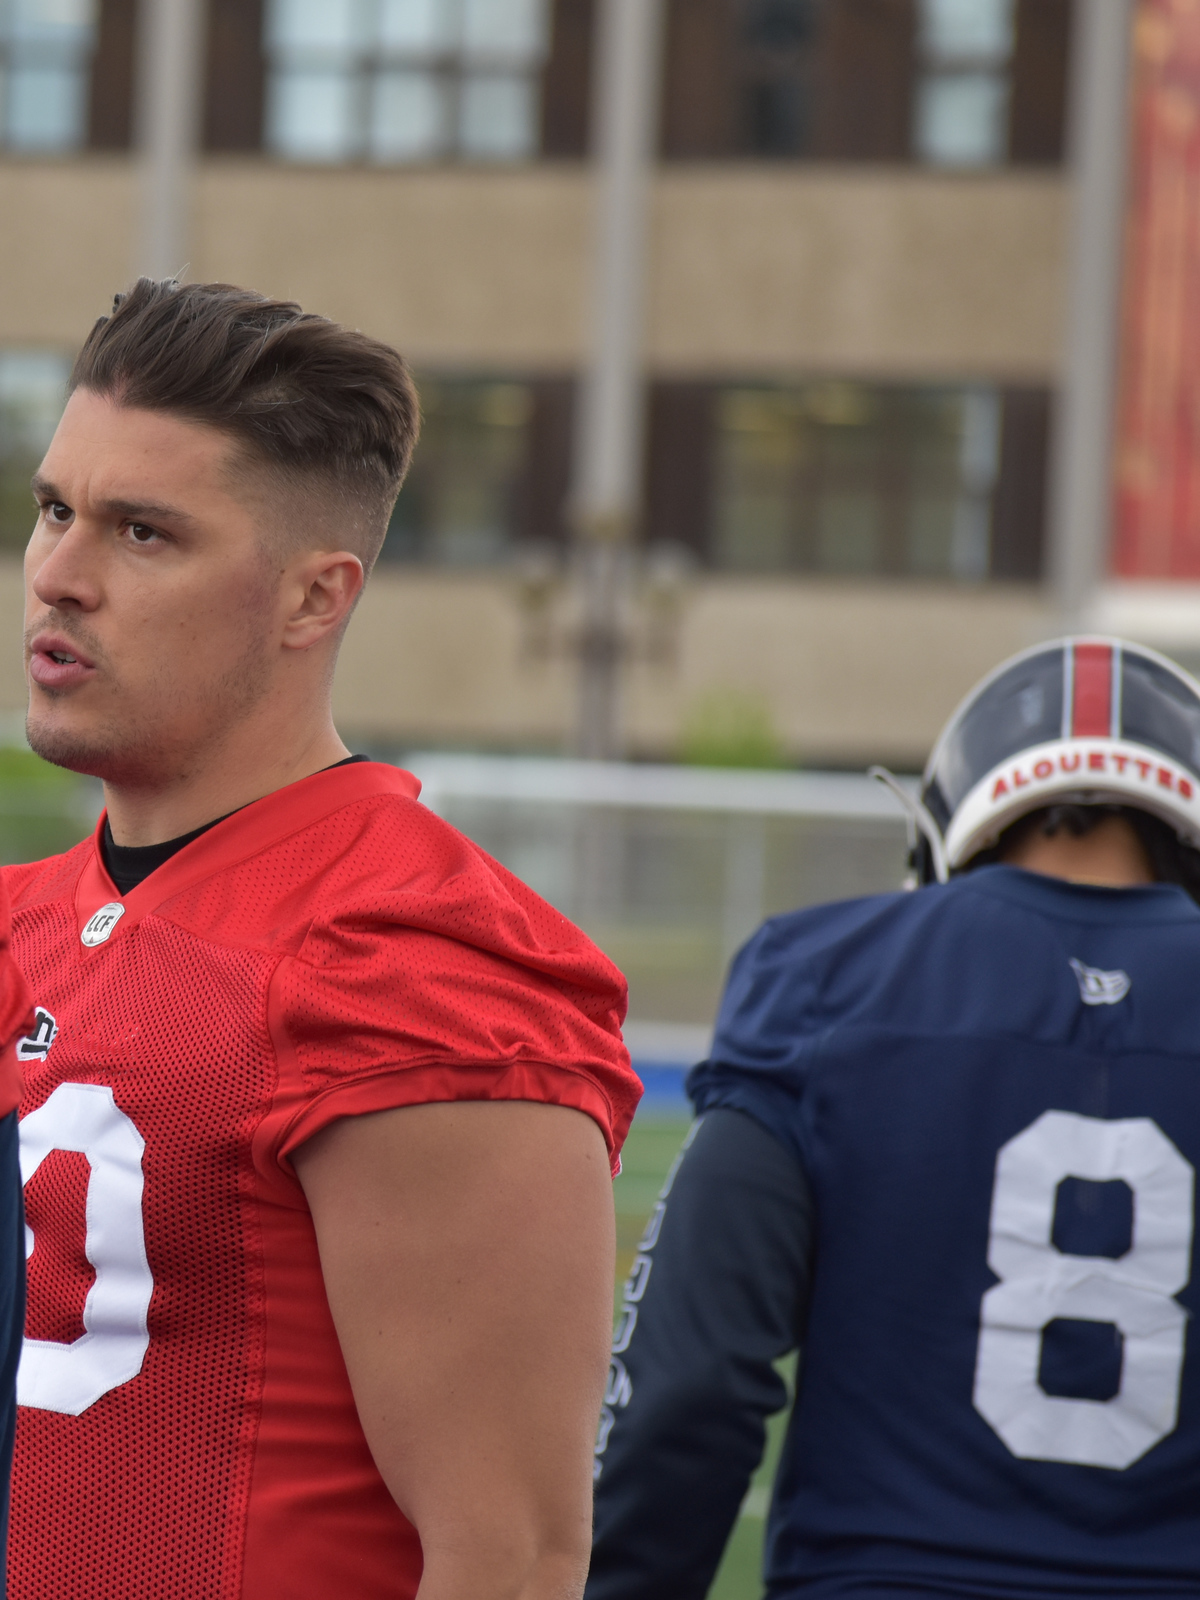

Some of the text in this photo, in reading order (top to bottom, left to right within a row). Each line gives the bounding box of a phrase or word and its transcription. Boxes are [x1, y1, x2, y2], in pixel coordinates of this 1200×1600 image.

[991, 753, 1195, 801] ALOUETTES
[86, 914, 115, 933] LCF
[972, 1108, 1195, 1471] 8
